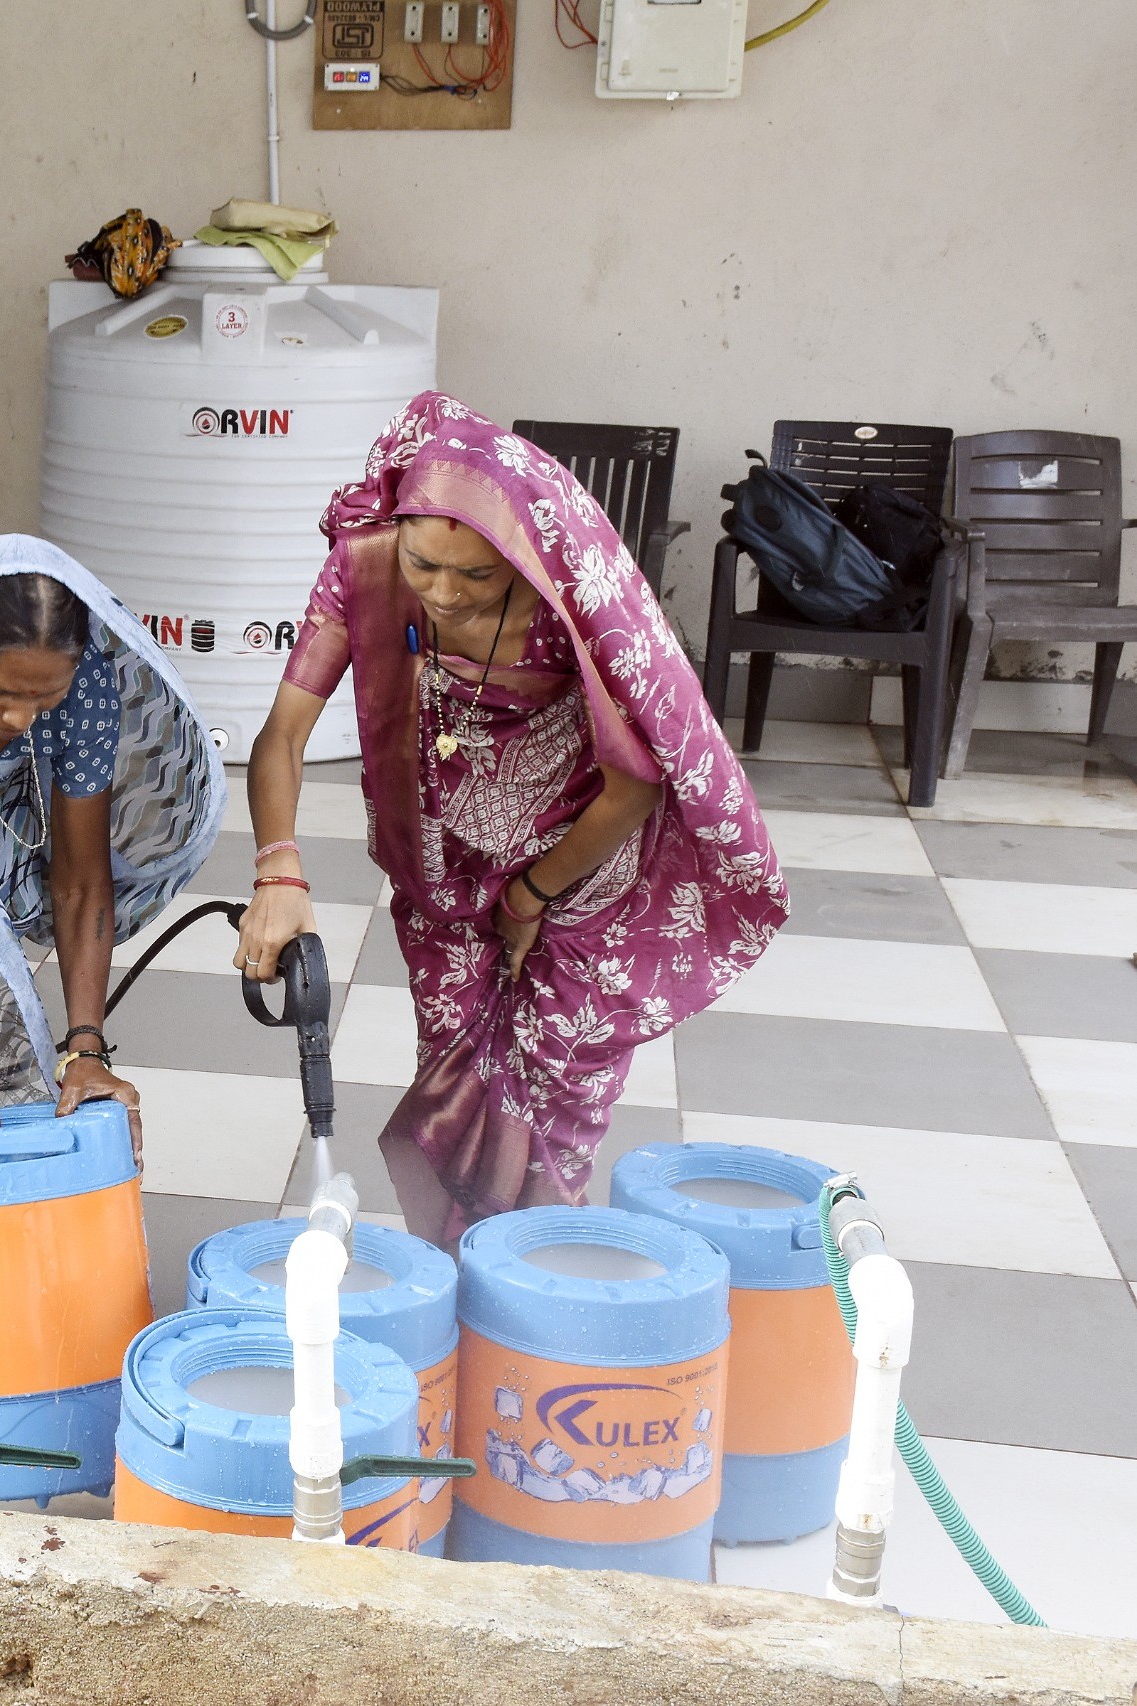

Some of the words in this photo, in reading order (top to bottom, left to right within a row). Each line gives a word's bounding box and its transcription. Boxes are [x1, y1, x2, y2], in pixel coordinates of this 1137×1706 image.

[327, 1, 380, 11] PLYWOOD
[228, 311, 236, 323] 3
[192, 406, 289, 436] ORVIN
[667, 1376, 683, 1386] ISO
[554, 1400, 681, 1447] KULEX
